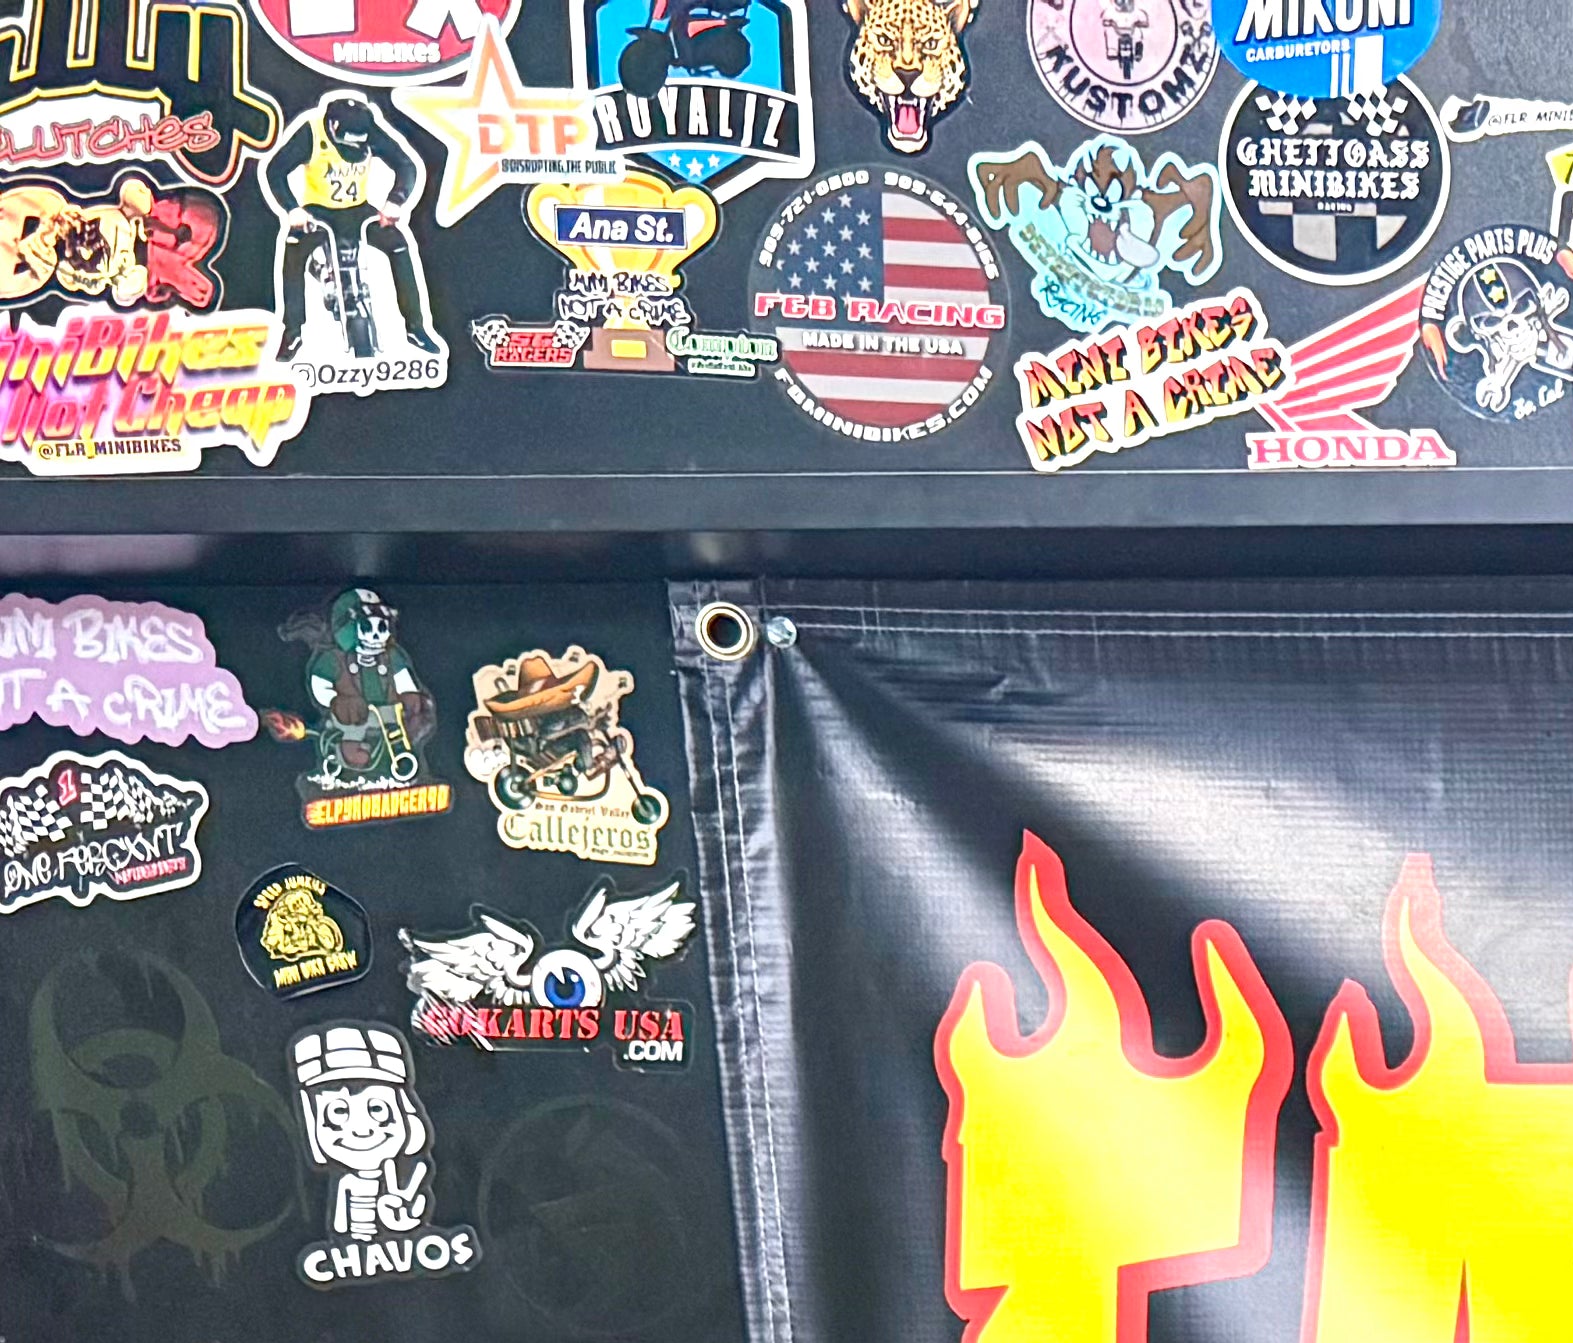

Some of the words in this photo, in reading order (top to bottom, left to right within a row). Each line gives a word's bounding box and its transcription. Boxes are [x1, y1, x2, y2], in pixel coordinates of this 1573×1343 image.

[333, 41, 441, 63] MINIBIKES
[1246, 38, 1350, 62] CARBURETORS
[478, 114, 589, 154] DTP
[330, 180, 359, 202] 24
[1248, 169, 1421, 200] MINIBIKES
[569, 212, 629, 241] Ana
[635, 214, 673, 242] St.
[1422, 246, 1470, 321] PRESTIGE
[1466, 228, 1516, 262] PARTS
[1516, 229, 1558, 265] PLUS
[848, 298, 1005, 329] RACING
[883, 336, 921, 352] THE
[924, 337, 963, 354] USA
[1026, 335, 1127, 408] MINI
[1136, 297, 1256, 374] BIKES
[1026, 402, 1111, 462] NOT
[1123, 390, 1160, 437] A
[1164, 347, 1284, 424] CRIME
[1251, 435, 1451, 464] HONDA
[504, 813, 650, 850] Callejeros
[614, 1010, 684, 1040] USA
[623, 1040, 683, 1061] .COM
[303, 1233, 474, 1282] CHAVOS
